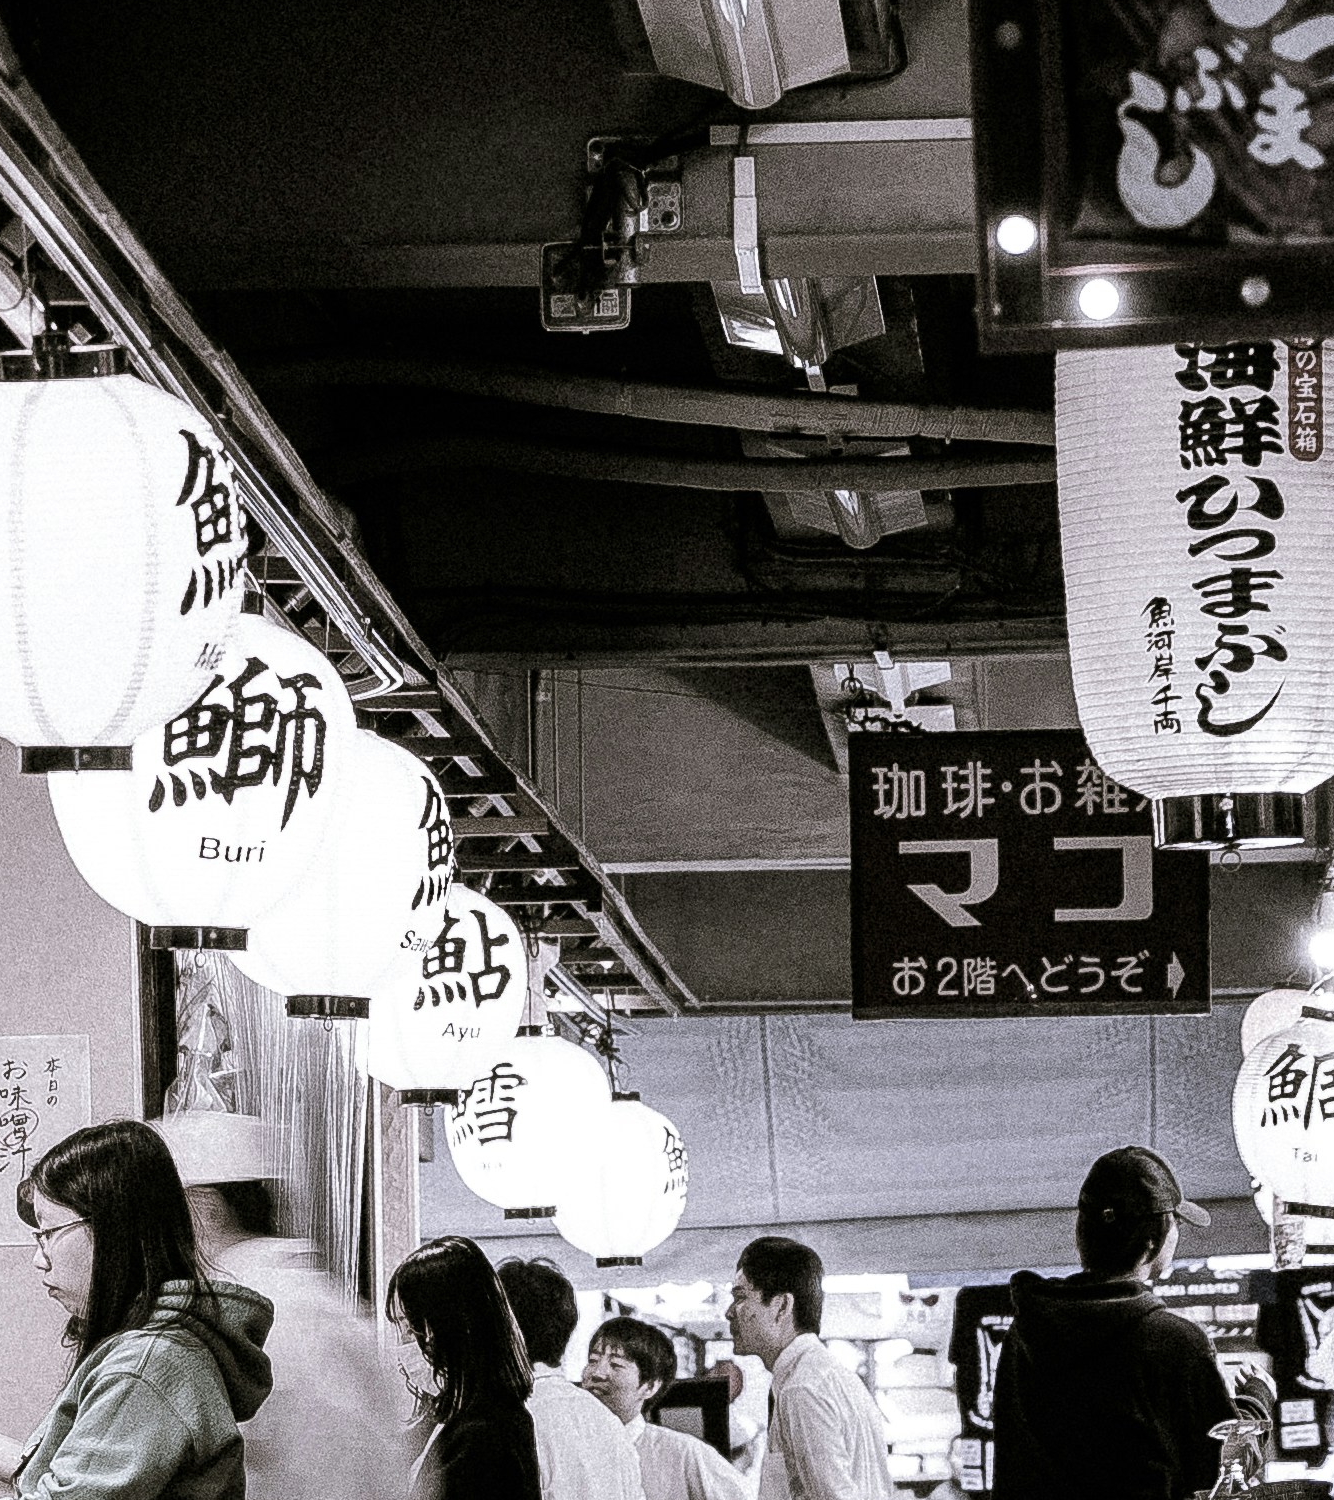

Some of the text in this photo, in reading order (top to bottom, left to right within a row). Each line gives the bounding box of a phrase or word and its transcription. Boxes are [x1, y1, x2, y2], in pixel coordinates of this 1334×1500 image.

[1293, 338, 1319, 453] の宝石箱
[1174, 341, 1290, 738] 海鮮ひつまぶし
[1140, 596, 1183, 736] 魚河岸千両
[149, 657, 327, 833] 鰤
[871, 757, 1153, 820] 珈琲・お雑
[198, 836, 267, 863] Buri
[898, 835, 1154, 928] マコ
[413, 909, 511, 1012] 鮎
[892, 948, 1151, 1000] お2階へどうぞ
[441, 1022, 481, 1043] Ayu
[43, 1056, 63, 1107] 本日の
[1291, 1146, 1319, 1163] Tai
